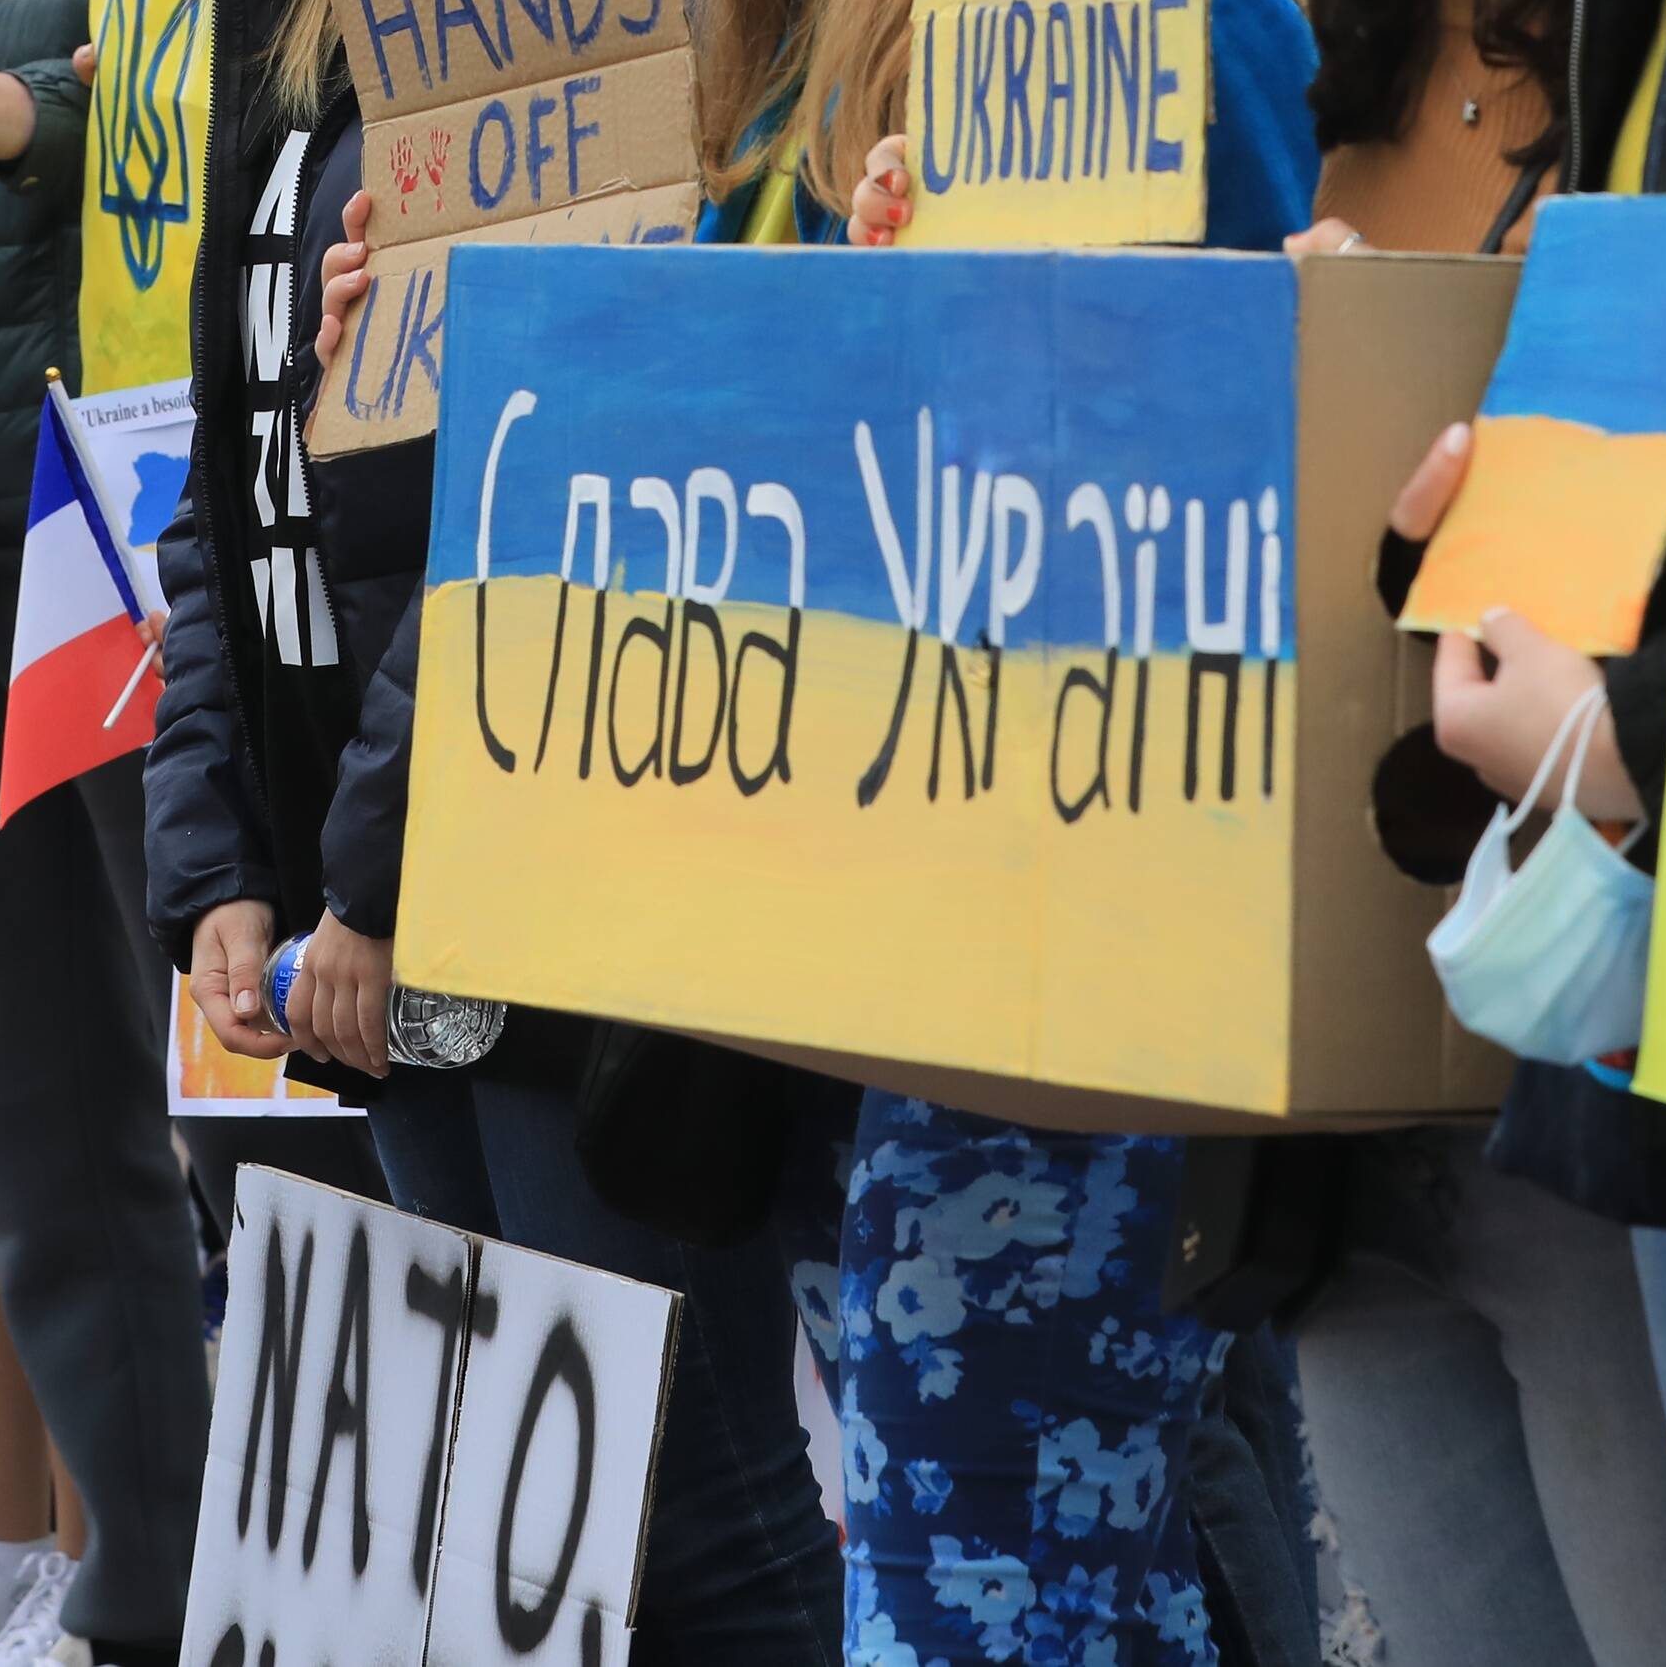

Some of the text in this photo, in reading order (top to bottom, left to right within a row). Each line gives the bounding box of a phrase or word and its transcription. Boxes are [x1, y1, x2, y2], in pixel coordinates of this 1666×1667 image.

[468, 75, 601, 211] OFF
[80, 403, 139, 428] 'Ukraine
[141, 403, 150, 416] a
[476, 389, 1282, 824] Слава Україні
